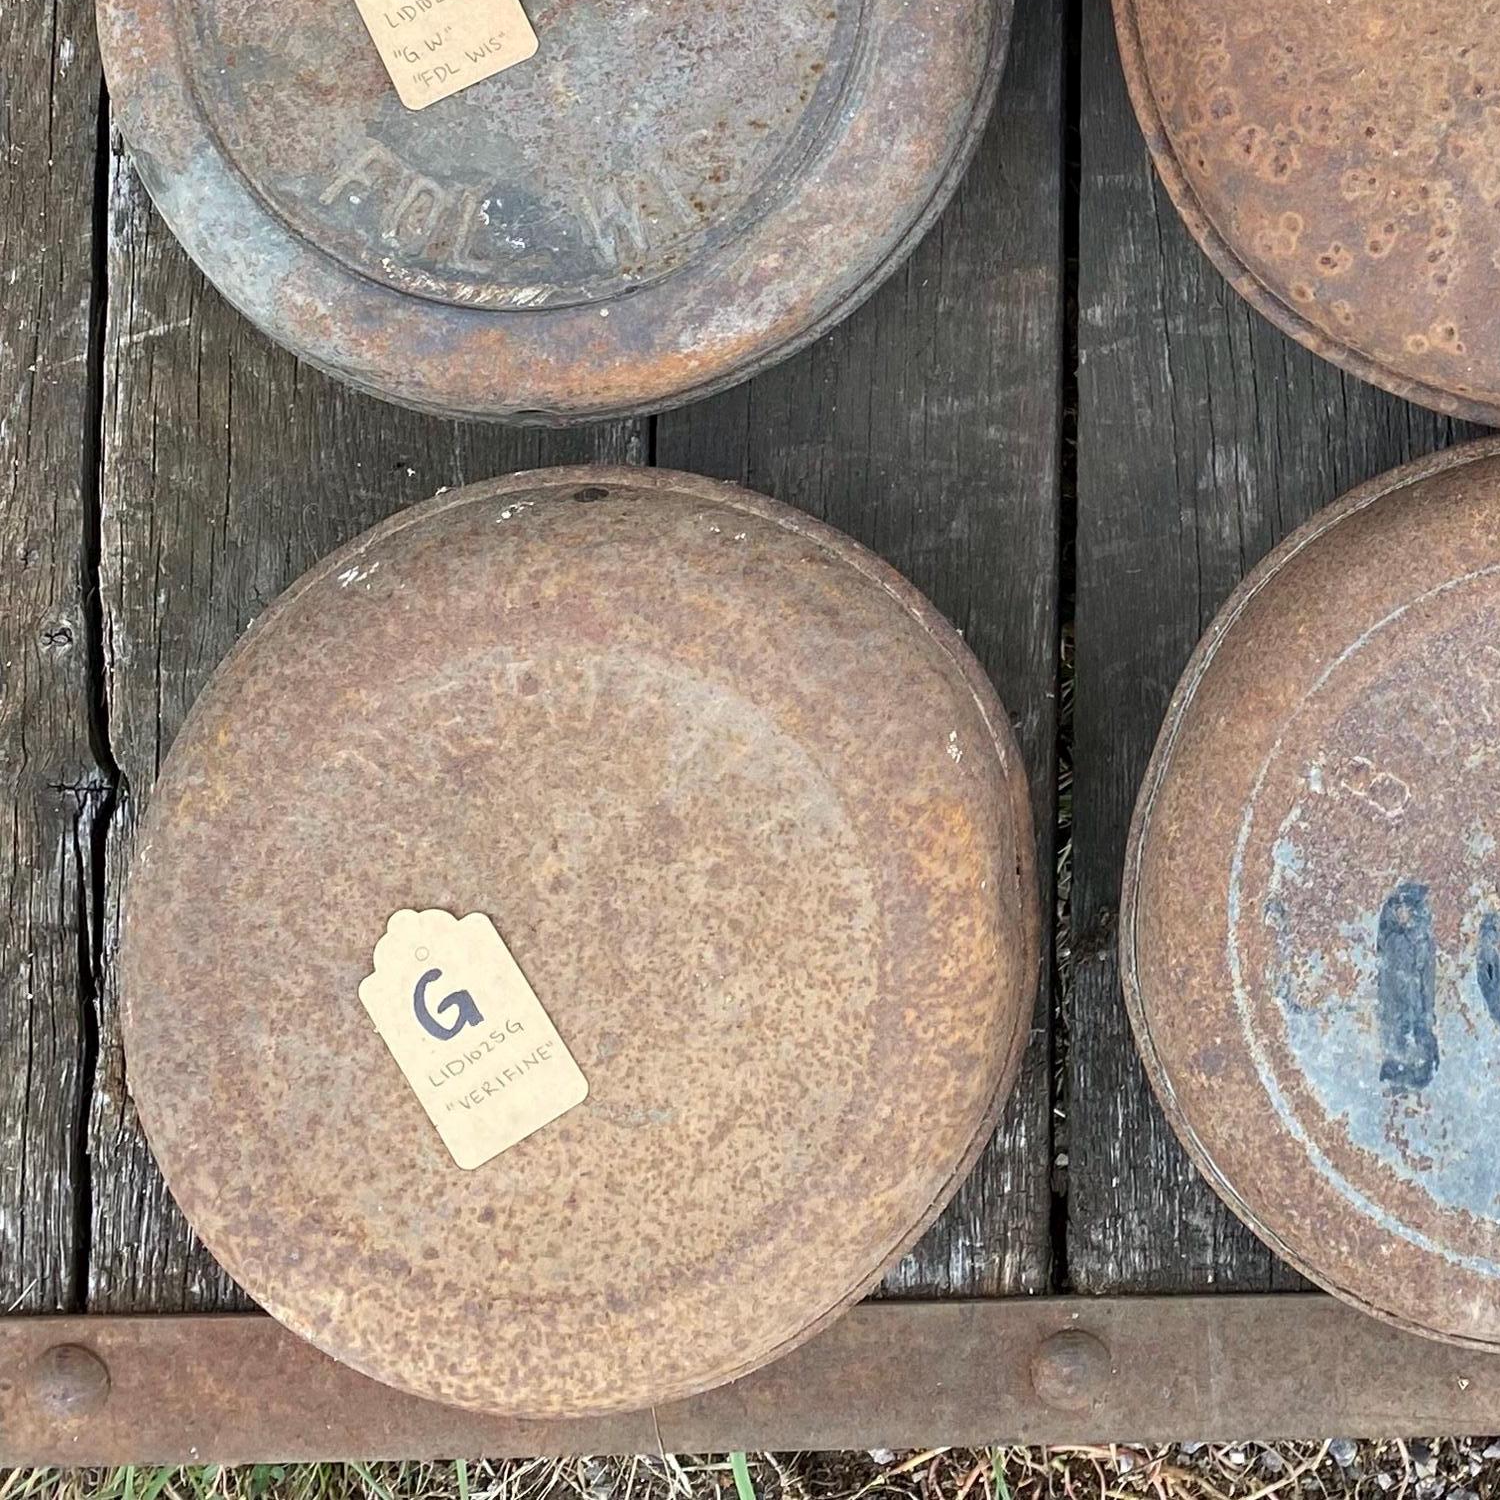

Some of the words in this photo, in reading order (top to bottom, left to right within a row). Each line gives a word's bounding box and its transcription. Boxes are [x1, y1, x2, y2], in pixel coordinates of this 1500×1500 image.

[413, 967, 485, 1041] G
[428, 1018, 525, 1088] LID1025G
[446, 1040, 555, 1112] "VERIFINE"
